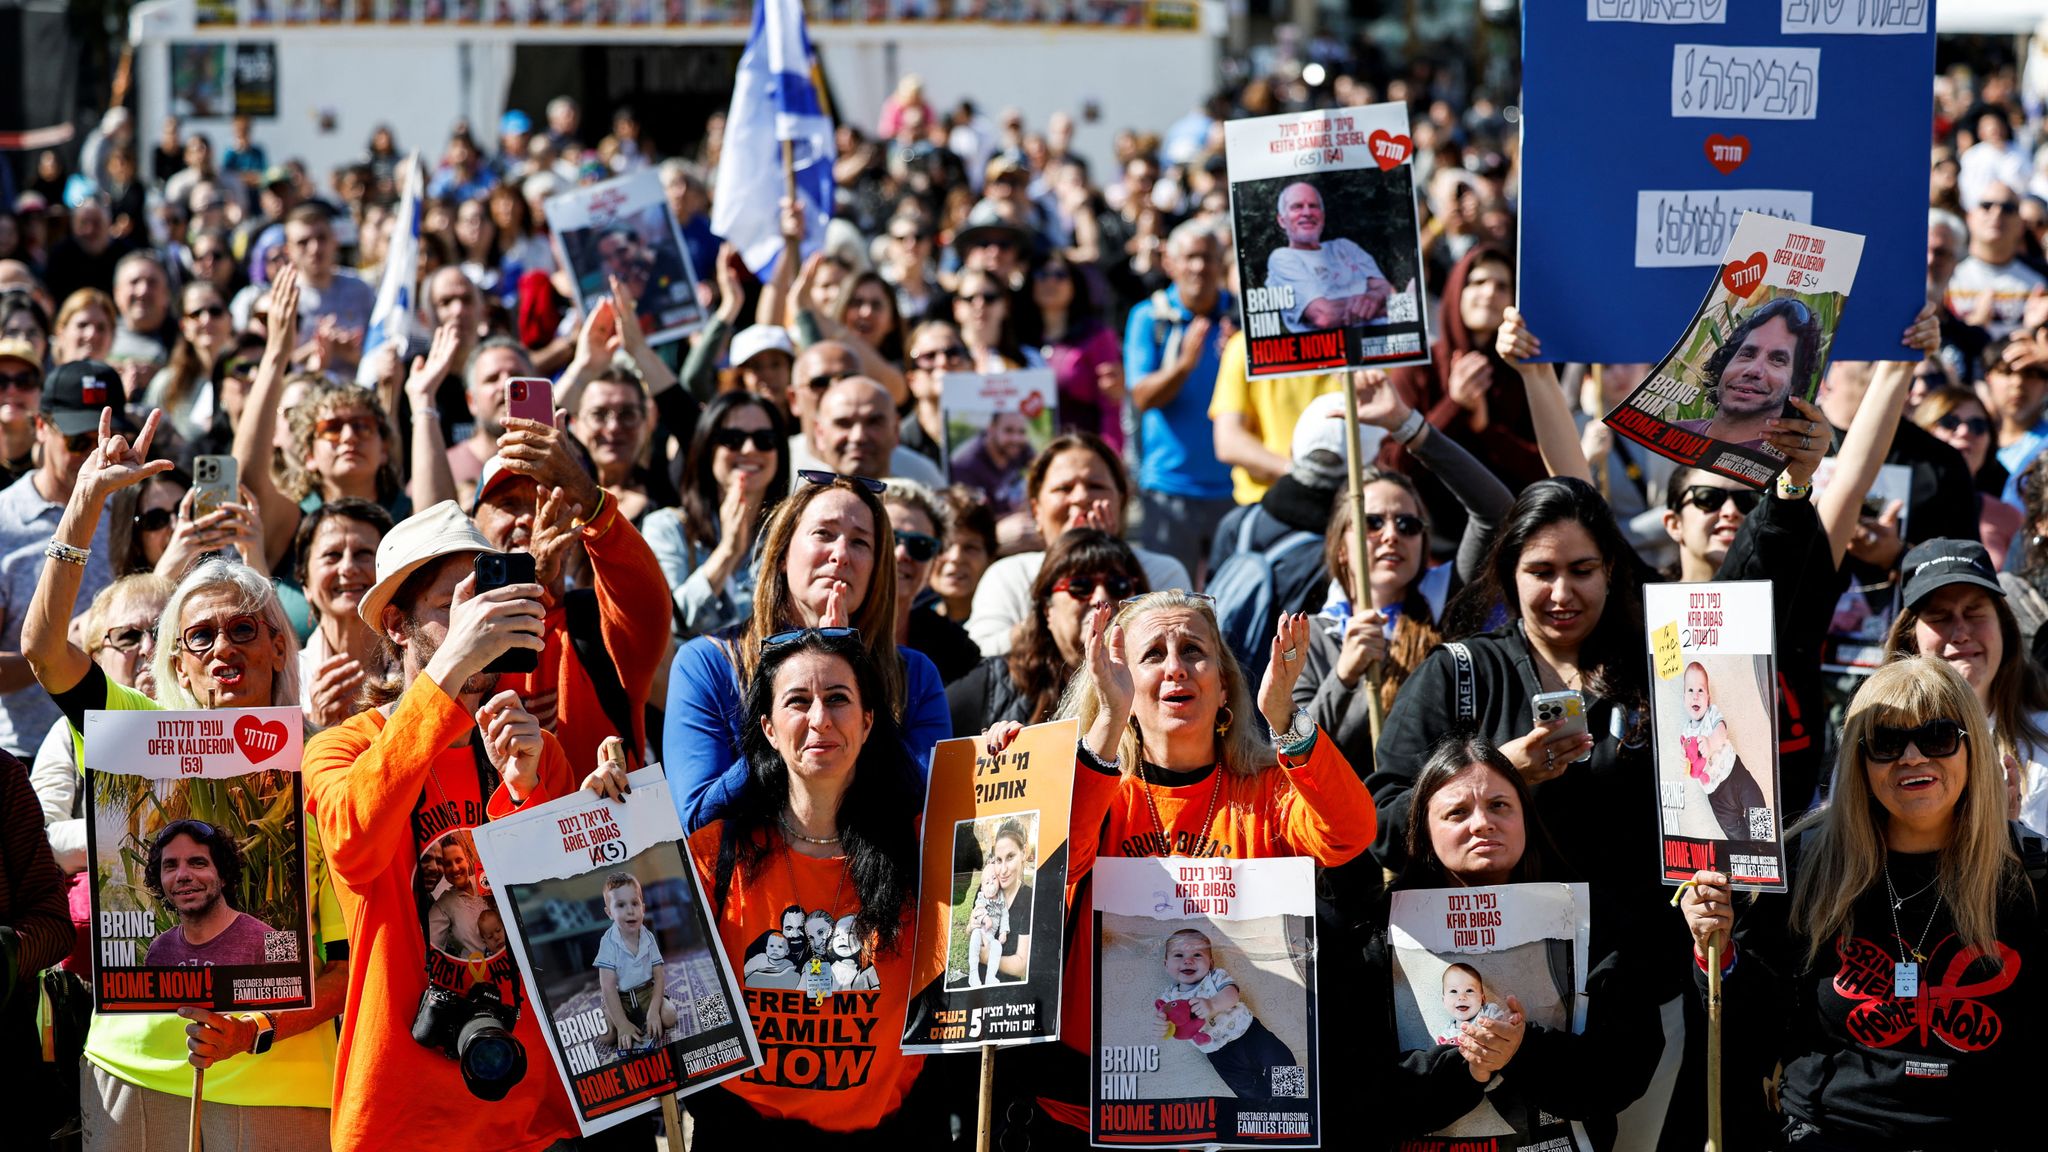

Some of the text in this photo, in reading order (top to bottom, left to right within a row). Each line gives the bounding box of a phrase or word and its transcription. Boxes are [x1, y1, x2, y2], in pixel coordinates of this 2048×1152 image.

[1681, 48, 1813, 115] הביתה!
[1270, 131, 1366, 154] KEITH SAMUEL SIEGEL
[1294, 152, 1321, 167] (65)
[1655, 194, 1726, 256] לכולם!
[1773, 249, 1825, 272] OFER KALDERON
[1730, 264, 1761, 288] חזרתי
[1246, 284, 1295, 313] BRING
[1249, 311, 1281, 338] HIM
[1252, 329, 1346, 365] HOME NOW!
[1645, 374, 1700, 406] BRING
[1629, 390, 1670, 417] HIM
[1613, 406, 1713, 459] HOME NOW!
[1713, 457, 1770, 484] FAMILIES FORUM
[1688, 611, 1723, 627] KFIR BIBAS
[1682, 629, 1692, 648] 2
[157, 719, 223, 738] עופר קלדרון
[244, 727, 278, 751] חזרתי
[148, 738, 234, 755] OFER KALDERON
[181, 756, 203, 774] (53)
[976, 751, 1030, 776] מי יציל
[975, 779, 1027, 804] אותנו?
[1660, 781, 1685, 809] BRING
[417, 800, 461, 843] BRING
[557, 807, 613, 835] אריאל ביבס
[1661, 809, 1680, 836] HIM
[562, 823, 621, 853] ARIEL BIBAS
[601, 840, 627, 861] (5)
[1122, 831, 1171, 857] BRING
[1664, 840, 1691, 868] HOME
[1179, 866, 1232, 881] כפיר ביבס
[1731, 863, 1779, 877] FAMILIES FORUM
[1175, 882, 1236, 898] KFIR BIBAS
[1448, 893, 1497, 911] כפיר ביבס
[100, 911, 156, 939] BRING
[1446, 911, 1502, 929] KFIR BIBAS
[101, 940, 136, 967] HIM
[102, 968, 214, 999] HOME NOW!
[232, 976, 302, 988] HOSTAGES AND MISSING
[1836, 960, 1898, 1000] THE
[233, 986, 303, 1001] FAMILIES FORUM
[483, 991, 500, 1001] Nikon
[743, 990, 880, 1015] FREE MY
[935, 1009, 967, 1024] בשבי
[968, 1007, 982, 1038] 5
[1006, 1003, 1036, 1016] אריאל
[555, 1008, 608, 1047] BRING
[930, 1026, 966, 1039] חמאס
[989, 1019, 1035, 1033] יום הולדת
[1849, 1000, 1918, 1043] HOME
[1932, 1000, 1998, 1046] NOW
[565, 1041, 600, 1076] HIM
[682, 1037, 740, 1061] HOSTAGES AND MISSING
[684, 1045, 745, 1075] FAMILIES FORUM
[1101, 1045, 1160, 1072] BRING
[576, 1047, 674, 1107] HOME NOW!
[744, 1047, 873, 1087] NOW
[1101, 1074, 1138, 1100] HIM
[1100, 1098, 1216, 1131] HOME NOW!
[1237, 1112, 1309, 1122] HOSTAGES AND MISSING
[1237, 1121, 1309, 1135] FAMILIES FORUM
